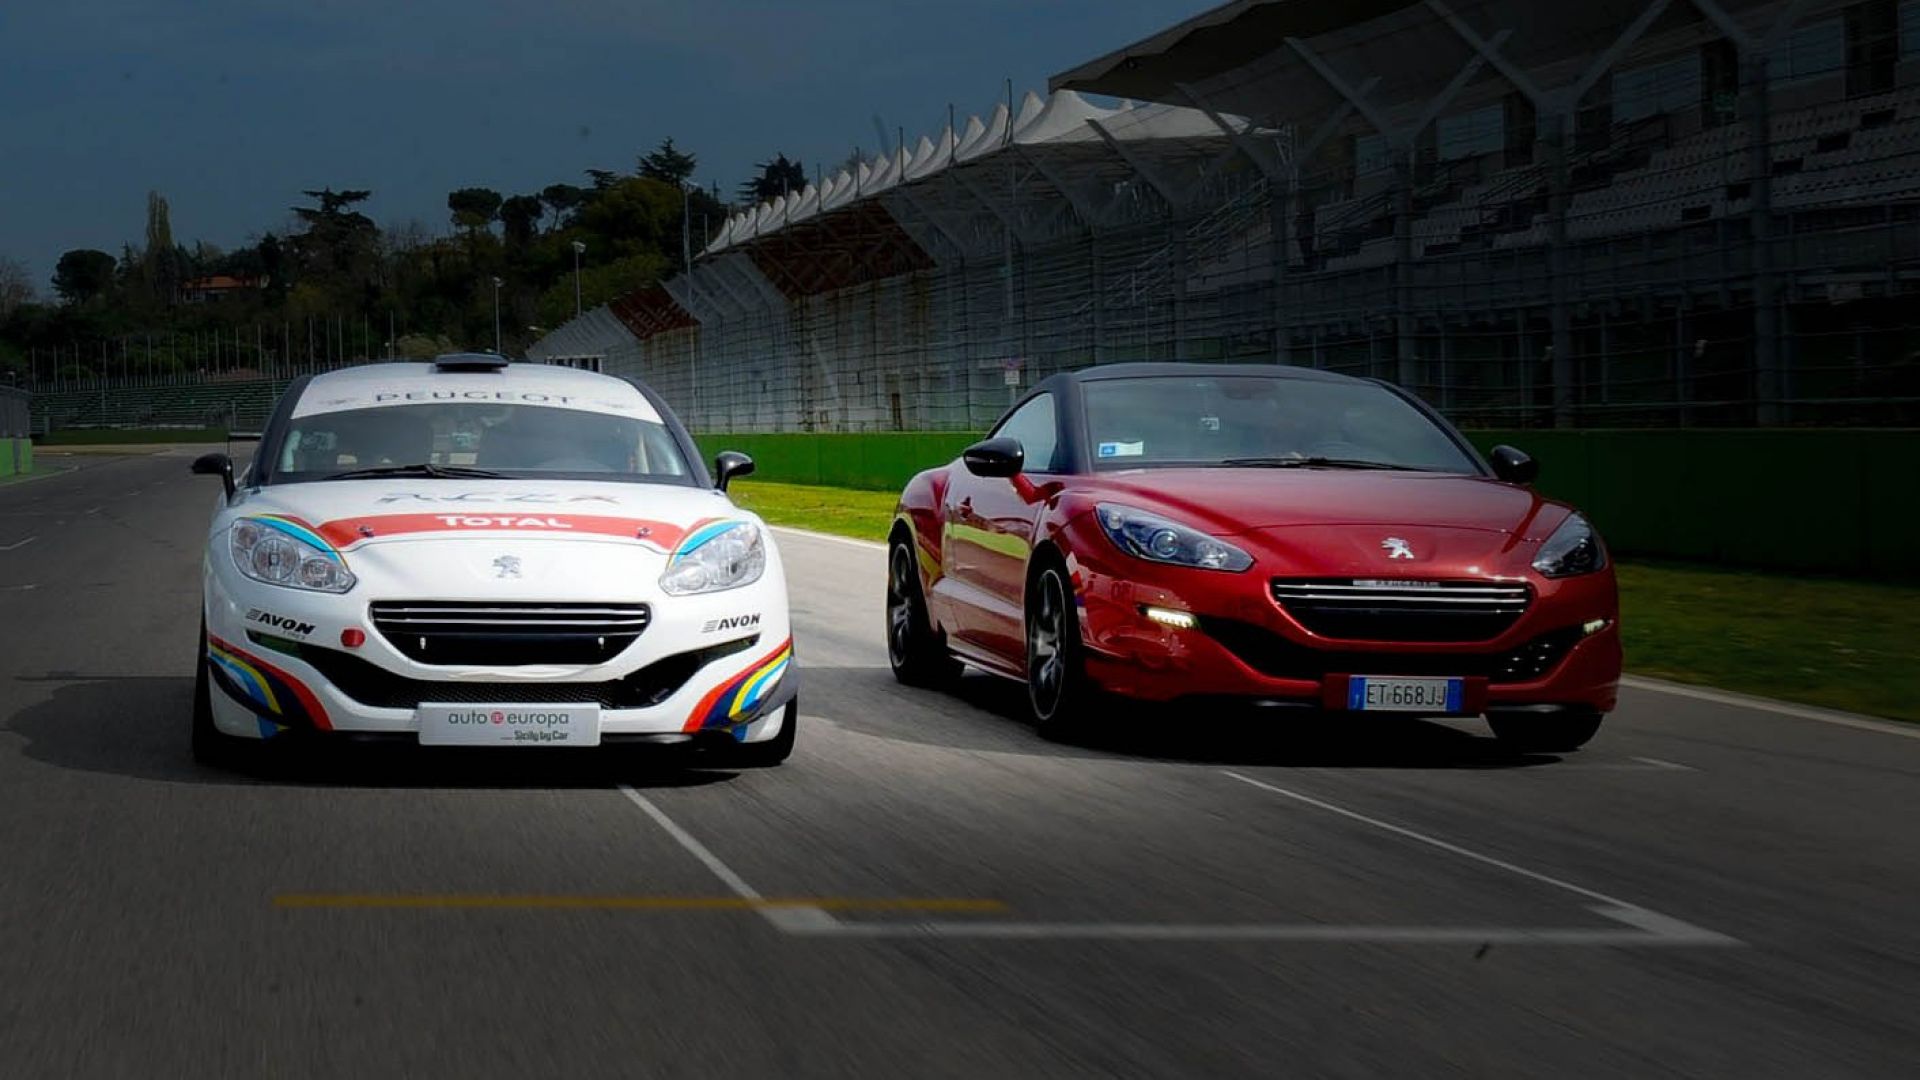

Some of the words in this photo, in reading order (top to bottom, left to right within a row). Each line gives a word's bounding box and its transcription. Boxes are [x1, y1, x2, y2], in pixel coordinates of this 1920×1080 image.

[376, 391, 575, 403] PEUGEOT
[435, 515, 573, 528] TOTAL
[258, 613, 316, 634] AVON
[718, 613, 761, 630] AVON
[1367, 684, 1388, 704] ET
[1393, 685, 1447, 706] 668JJ
[448, 711, 488, 725] auto
[507, 711, 570, 728] europa
[540, 730, 551, 742] by
[552, 730, 569, 741] Car
